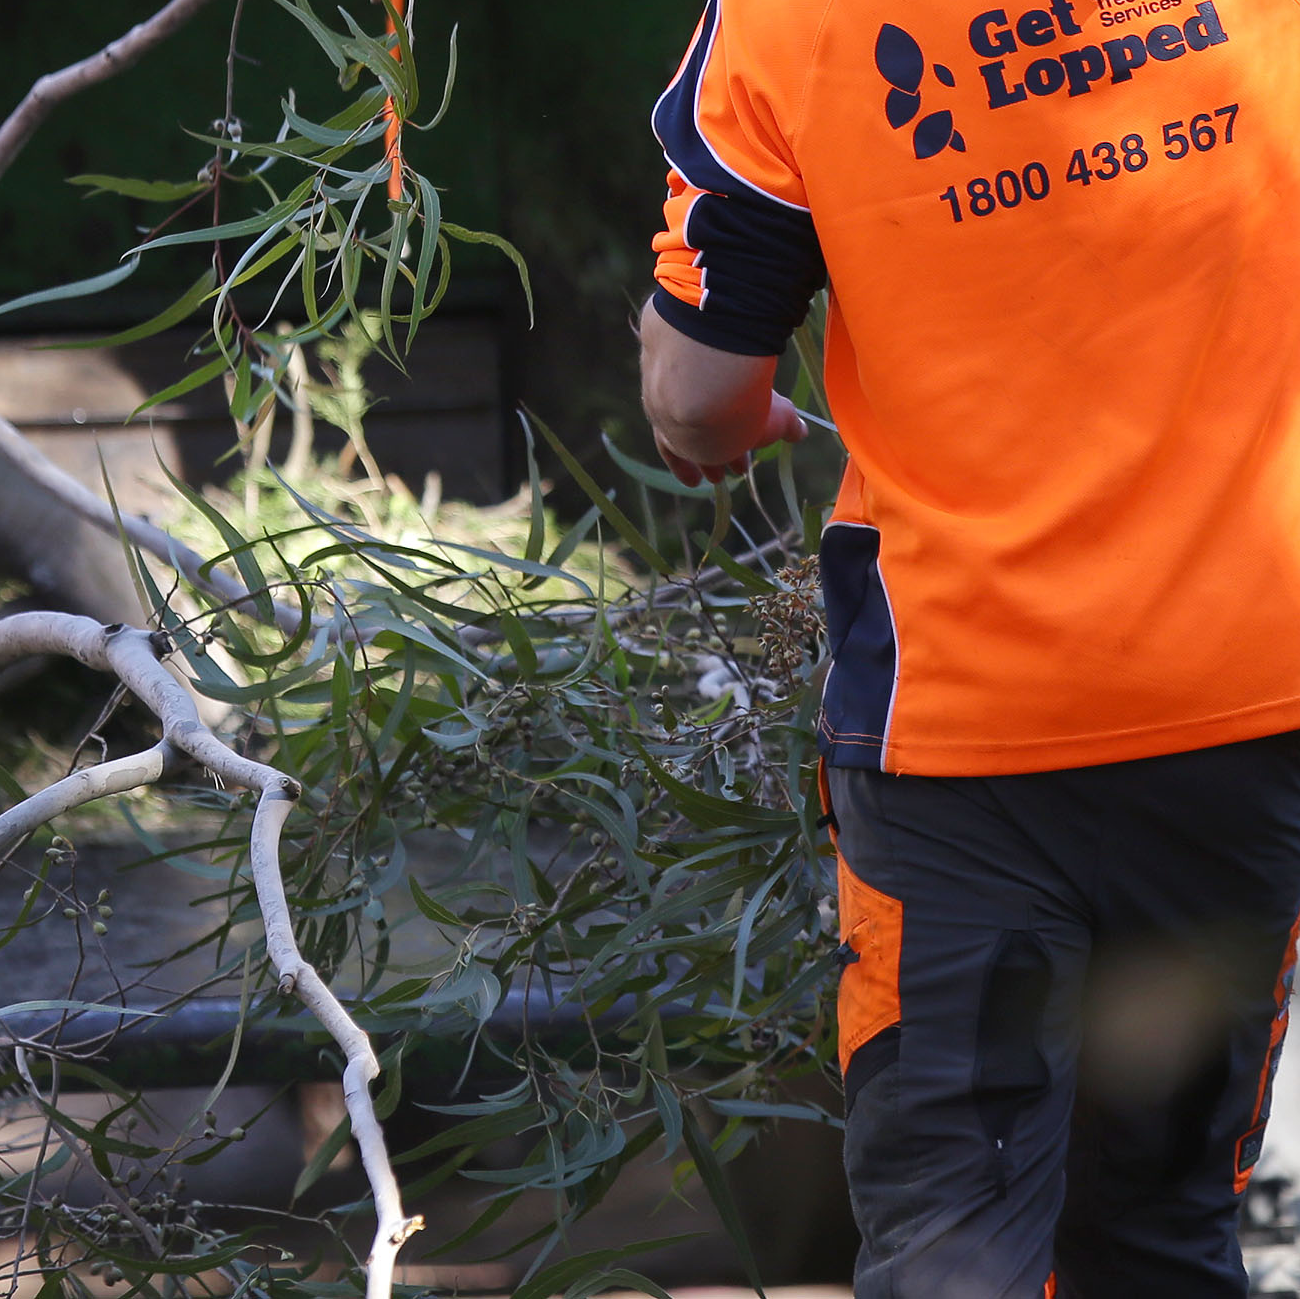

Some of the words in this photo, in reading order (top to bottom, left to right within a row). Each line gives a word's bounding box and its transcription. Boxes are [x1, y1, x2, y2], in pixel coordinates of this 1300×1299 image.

[979, 0, 1229, 109] Lopped
[940, 161, 1051, 223] 1800
[1065, 133, 1149, 187] 438
[1162, 103, 1241, 160] 567
